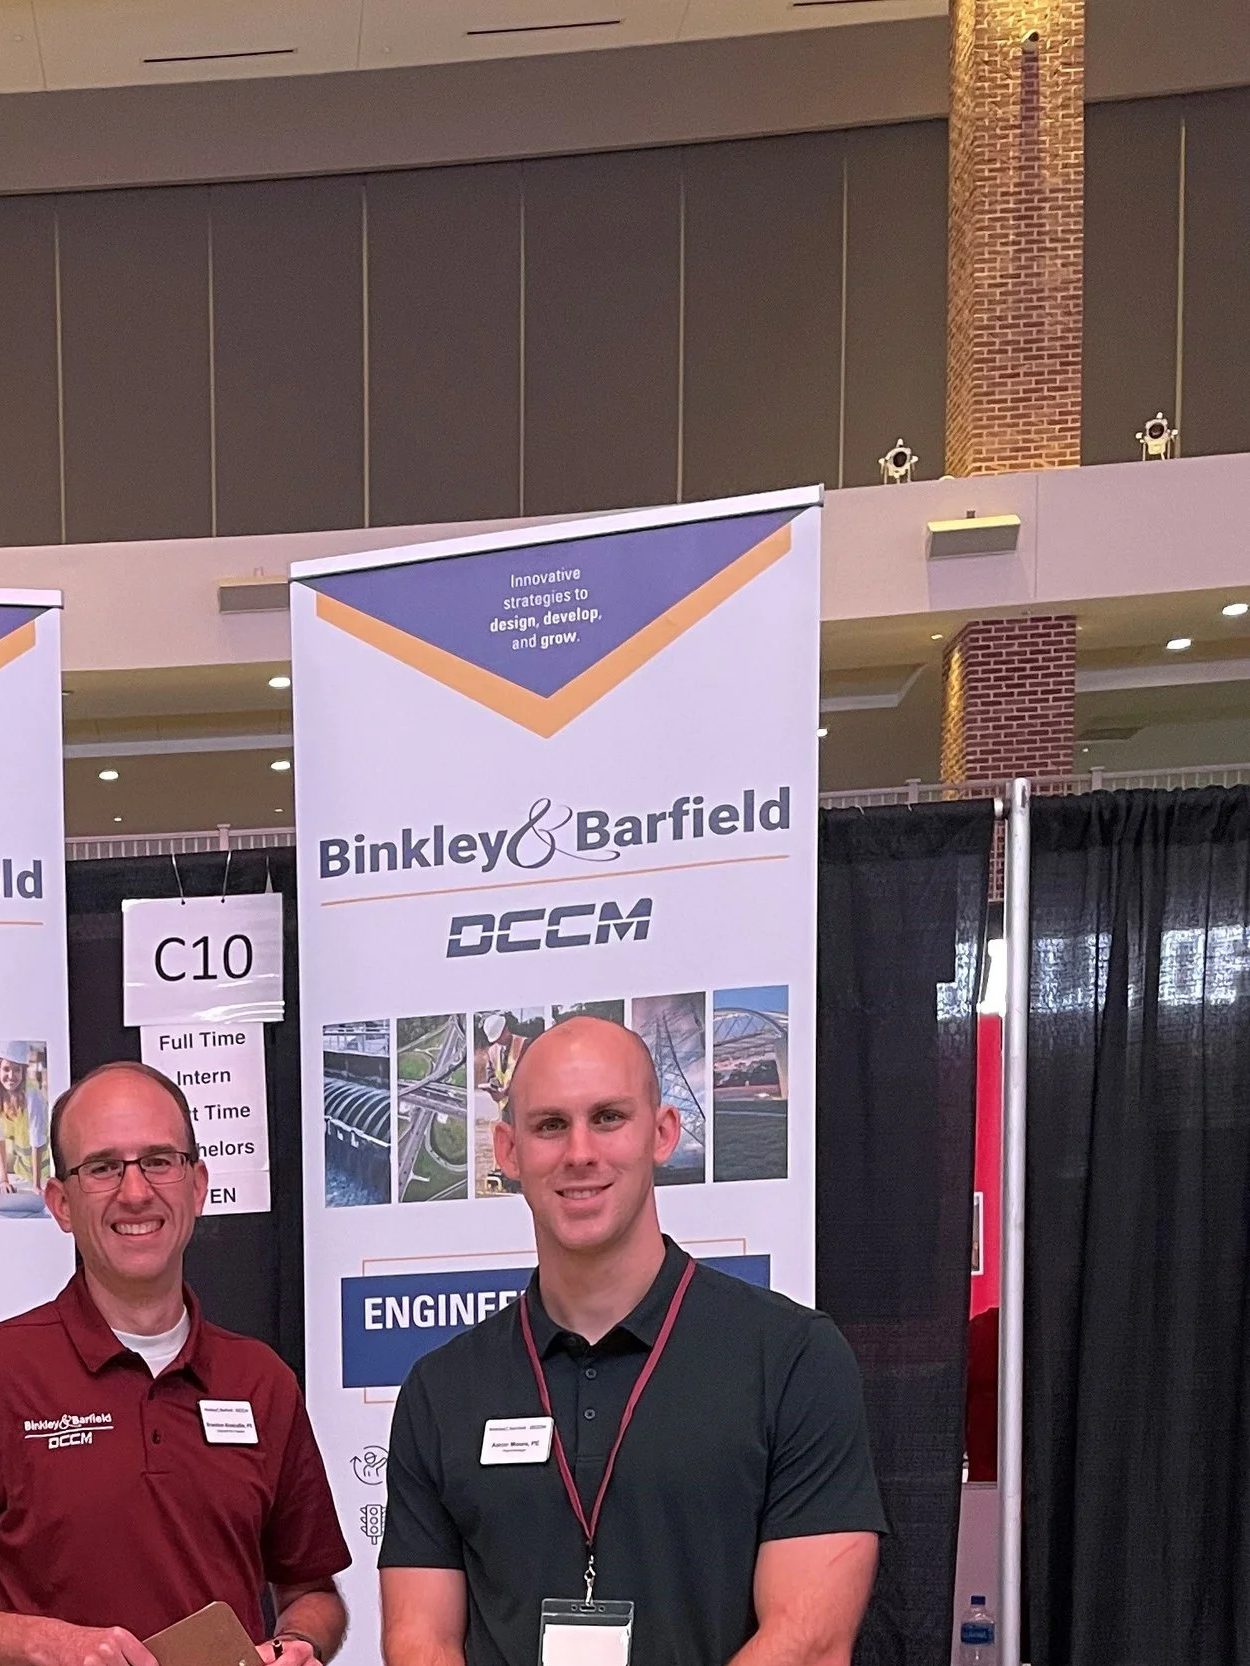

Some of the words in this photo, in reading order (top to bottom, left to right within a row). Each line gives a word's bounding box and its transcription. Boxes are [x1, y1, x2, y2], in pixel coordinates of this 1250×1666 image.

[510, 566, 581, 588] Innovative
[503, 589, 572, 610] strategies
[574, 586, 589, 602] to
[489, 613, 540, 633] design,
[542, 607, 603, 628] develop,
[511, 634, 537, 650] and
[540, 630, 580, 649] grow.
[446, 897, 653, 959] DCCM
[154, 933, 254, 982] C10
[159, 1035, 193, 1051] Full
[199, 1031, 246, 1047] Time
[177, 1070, 231, 1086] Intern
[204, 1104, 251, 1120] Time
[196, 1140, 255, 1158] helors
[208, 1186, 237, 1204] EN
[48, 1431, 93, 1449] DCCM
